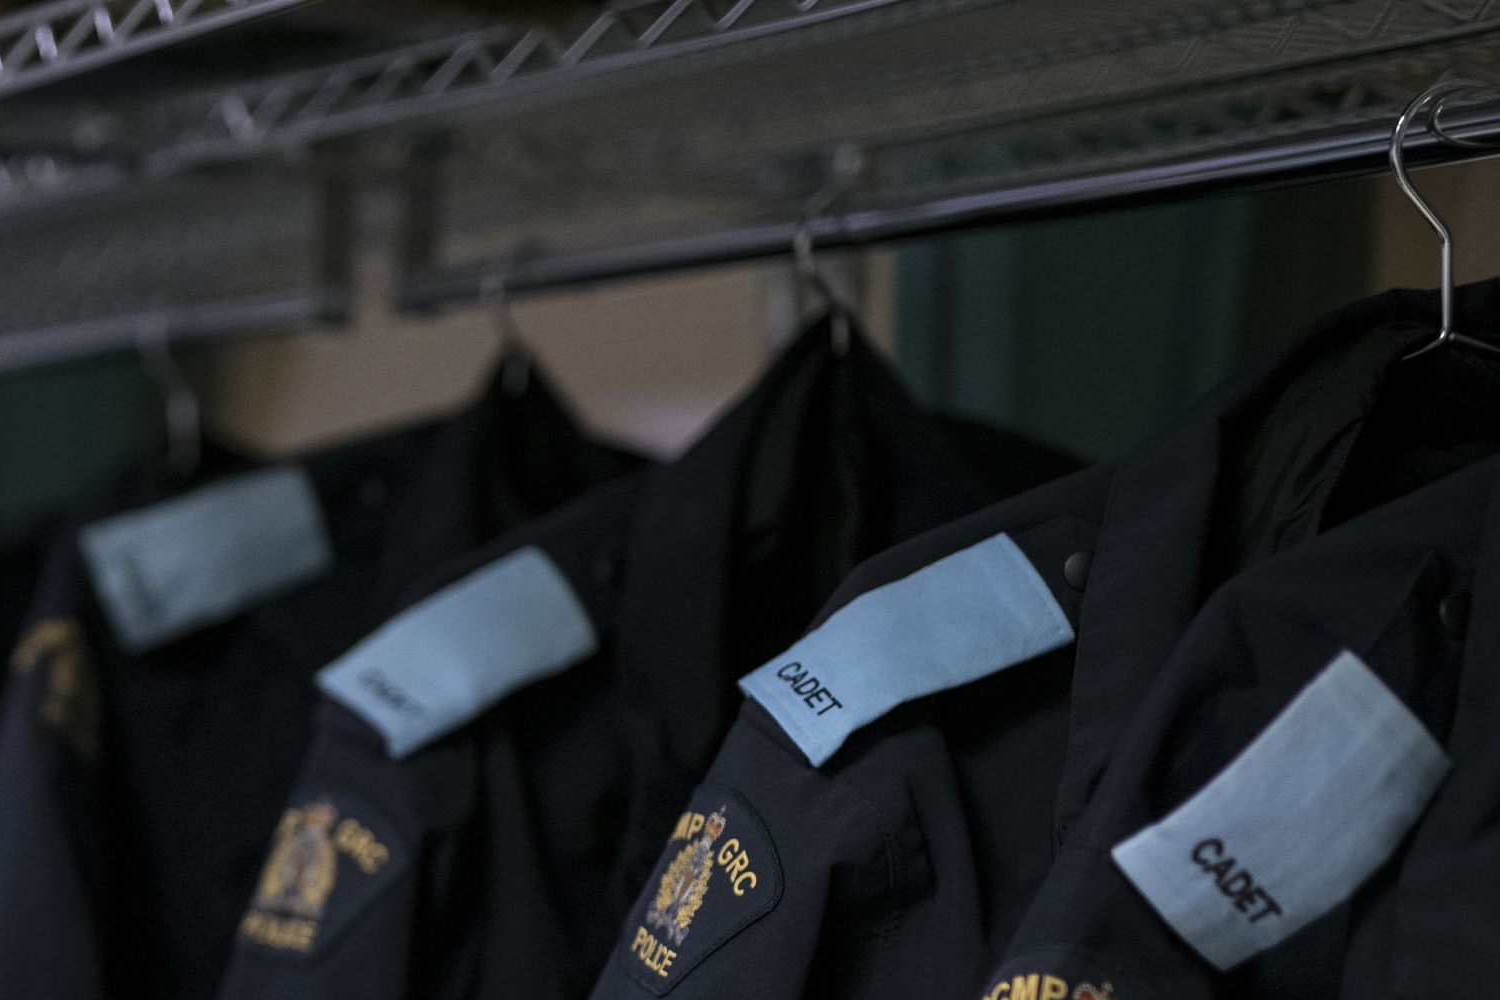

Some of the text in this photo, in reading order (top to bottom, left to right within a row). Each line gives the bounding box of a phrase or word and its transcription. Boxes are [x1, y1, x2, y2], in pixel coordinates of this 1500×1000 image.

[777, 661, 843, 716] CADET
[671, 811, 757, 896] MP GRC
[1190, 837, 1283, 923] CADET
[631, 926, 678, 977] POLICE
